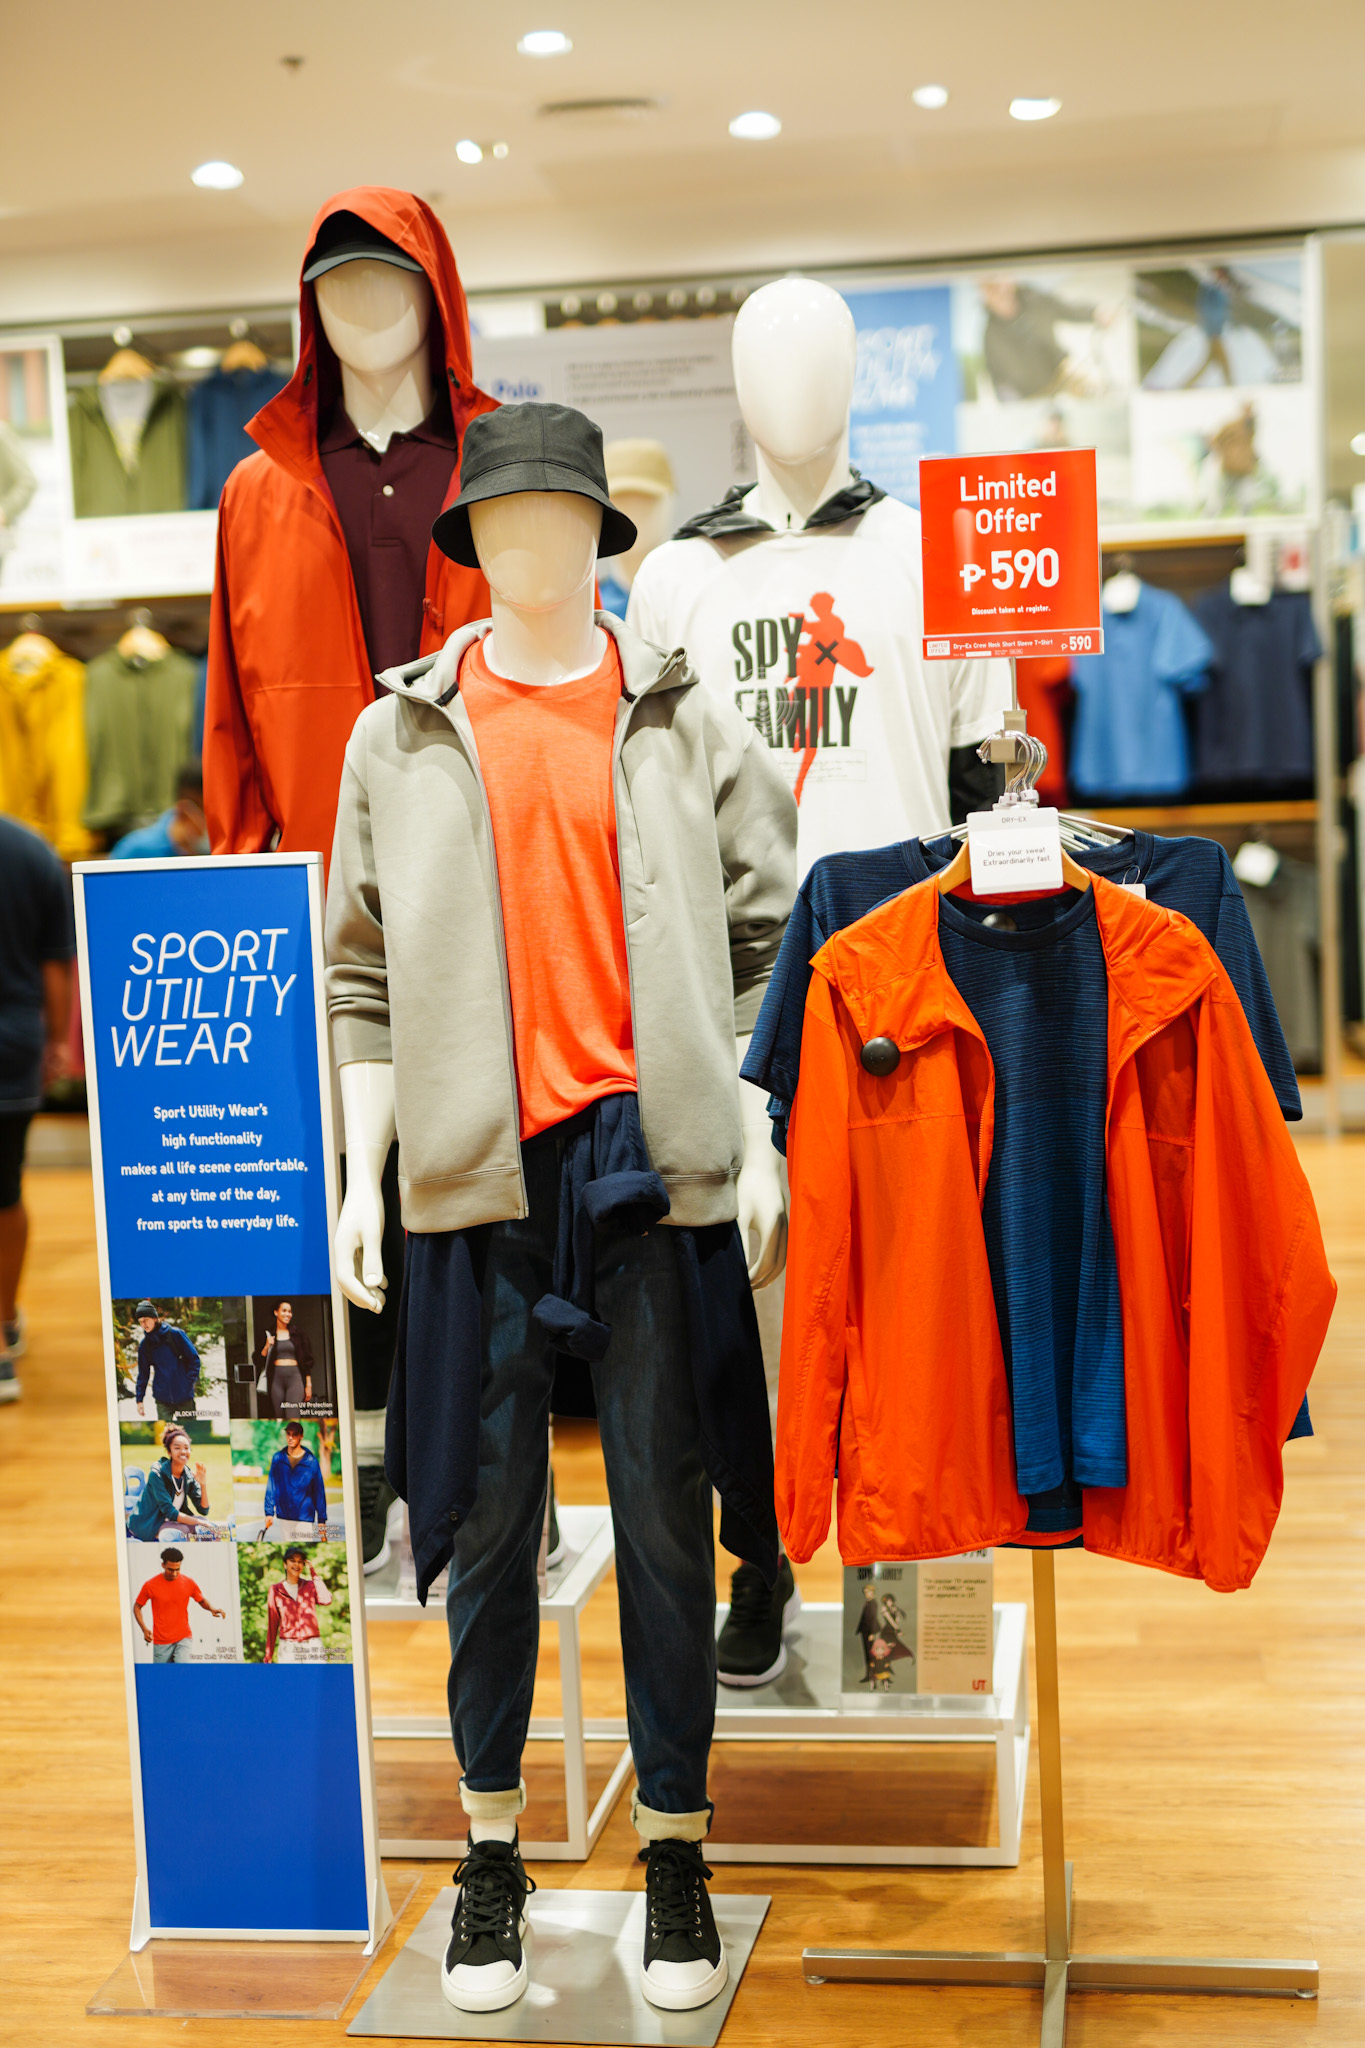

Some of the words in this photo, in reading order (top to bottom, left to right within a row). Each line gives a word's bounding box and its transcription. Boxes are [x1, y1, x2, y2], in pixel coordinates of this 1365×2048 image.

[960, 471, 1057, 502] Limited
[975, 508, 1043, 535] Offer
[972, 607, 997, 616] Discount
[1026, 605, 1051, 613] register.
[732, 617, 804, 682] SPY
[983, 856, 1034, 866] Extraordinarily
[1008, 849, 1022, 857] your
[129, 928, 289, 976] SPORT
[122, 974, 297, 1022] UTILITY
[111, 1022, 252, 1068] WEAR
[154, 1105, 186, 1122] Sport
[188, 1104, 225, 1120] Utility
[162, 1133, 186, 1150] high
[189, 1131, 262, 1147] functionality
[121, 1162, 157, 1176] makes
[160, 1162, 174, 1174] all
[177, 1161, 196, 1174] life
[199, 1163, 231, 1173] scene
[234, 1158, 308, 1172] comfortable,
[152, 1190, 164, 1203] at
[167, 1192, 187, 1205] any
[190, 1189, 216, 1202] time
[219, 1188, 232, 1201] of
[234, 1187, 254, 1200] the
[257, 1187, 280, 1203] day,
[137, 1218, 165, 1231] from
[168, 1216, 203, 1233] sports
[206, 1216, 218, 1228] to
[221, 1215, 273, 1231] everyday
[276, 1214, 298, 1228] life.
